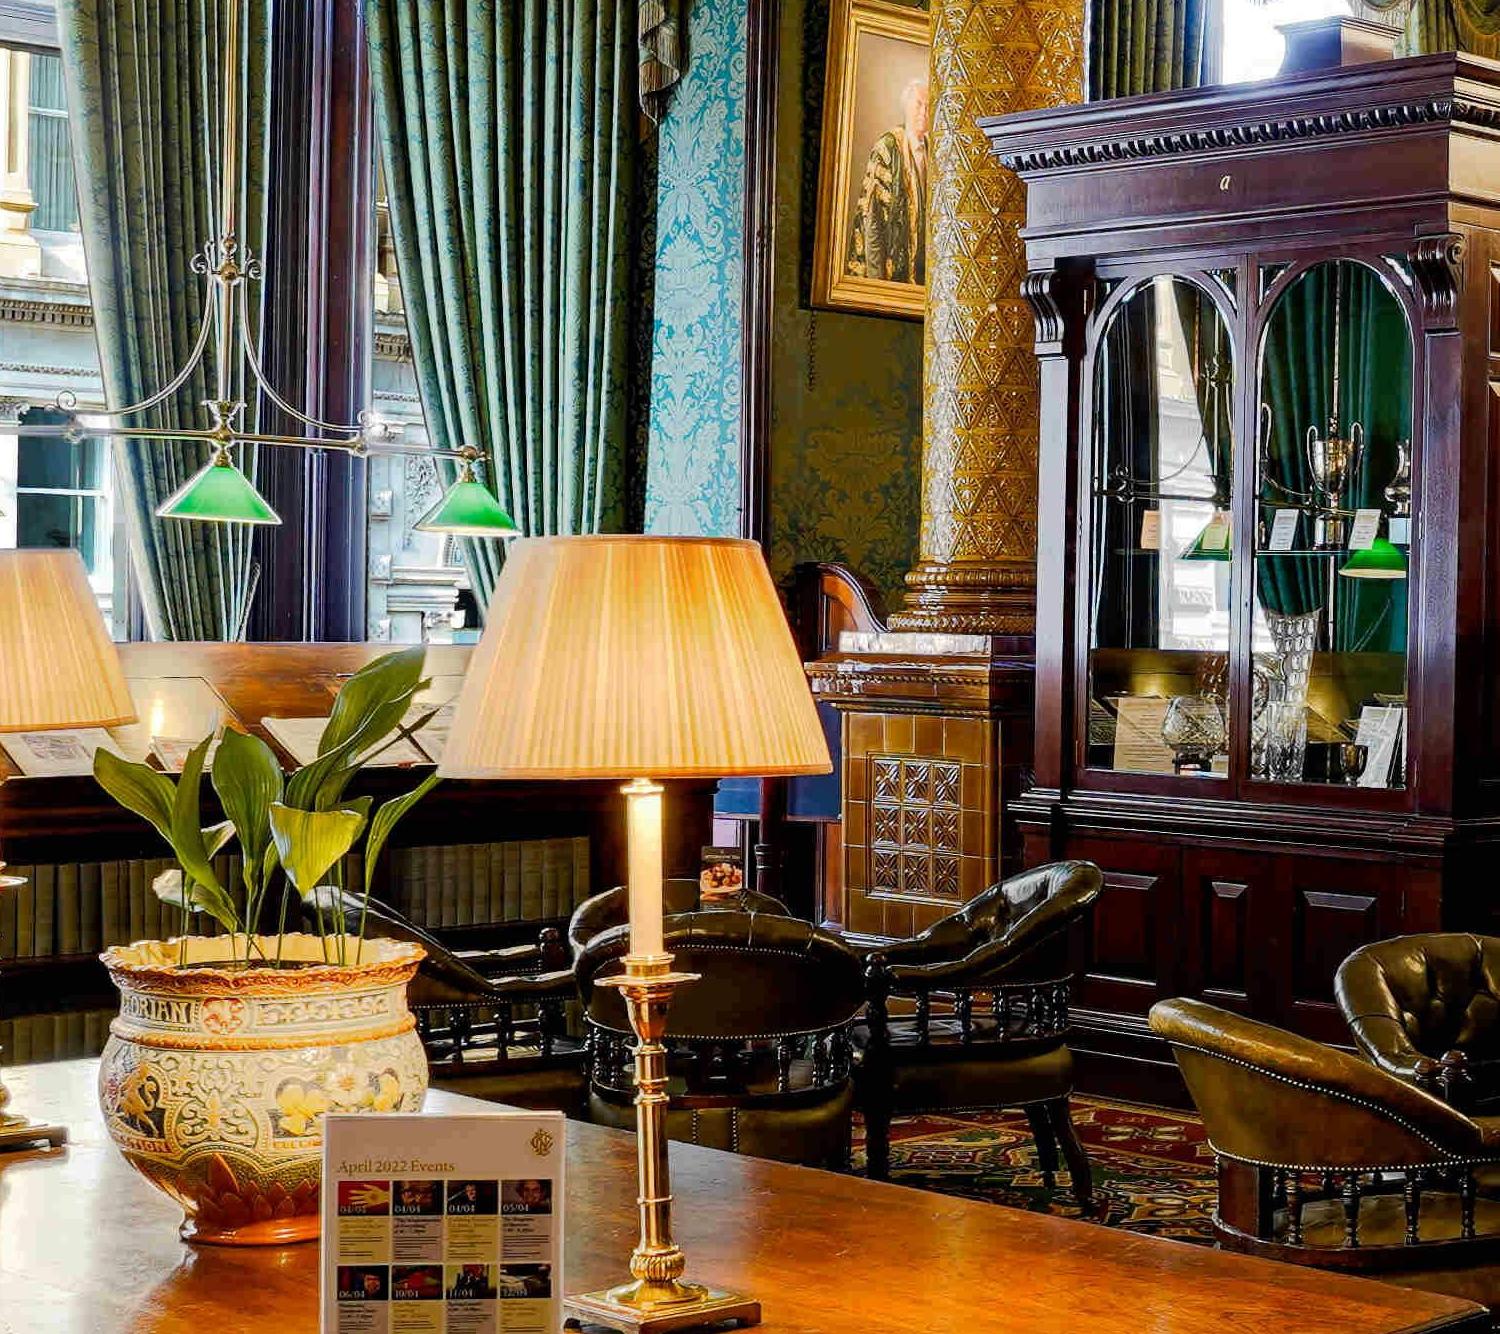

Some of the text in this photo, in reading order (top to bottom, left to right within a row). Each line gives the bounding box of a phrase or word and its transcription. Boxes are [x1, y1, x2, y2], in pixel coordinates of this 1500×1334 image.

[337, 1158, 455, 1176] April 2022 Events
